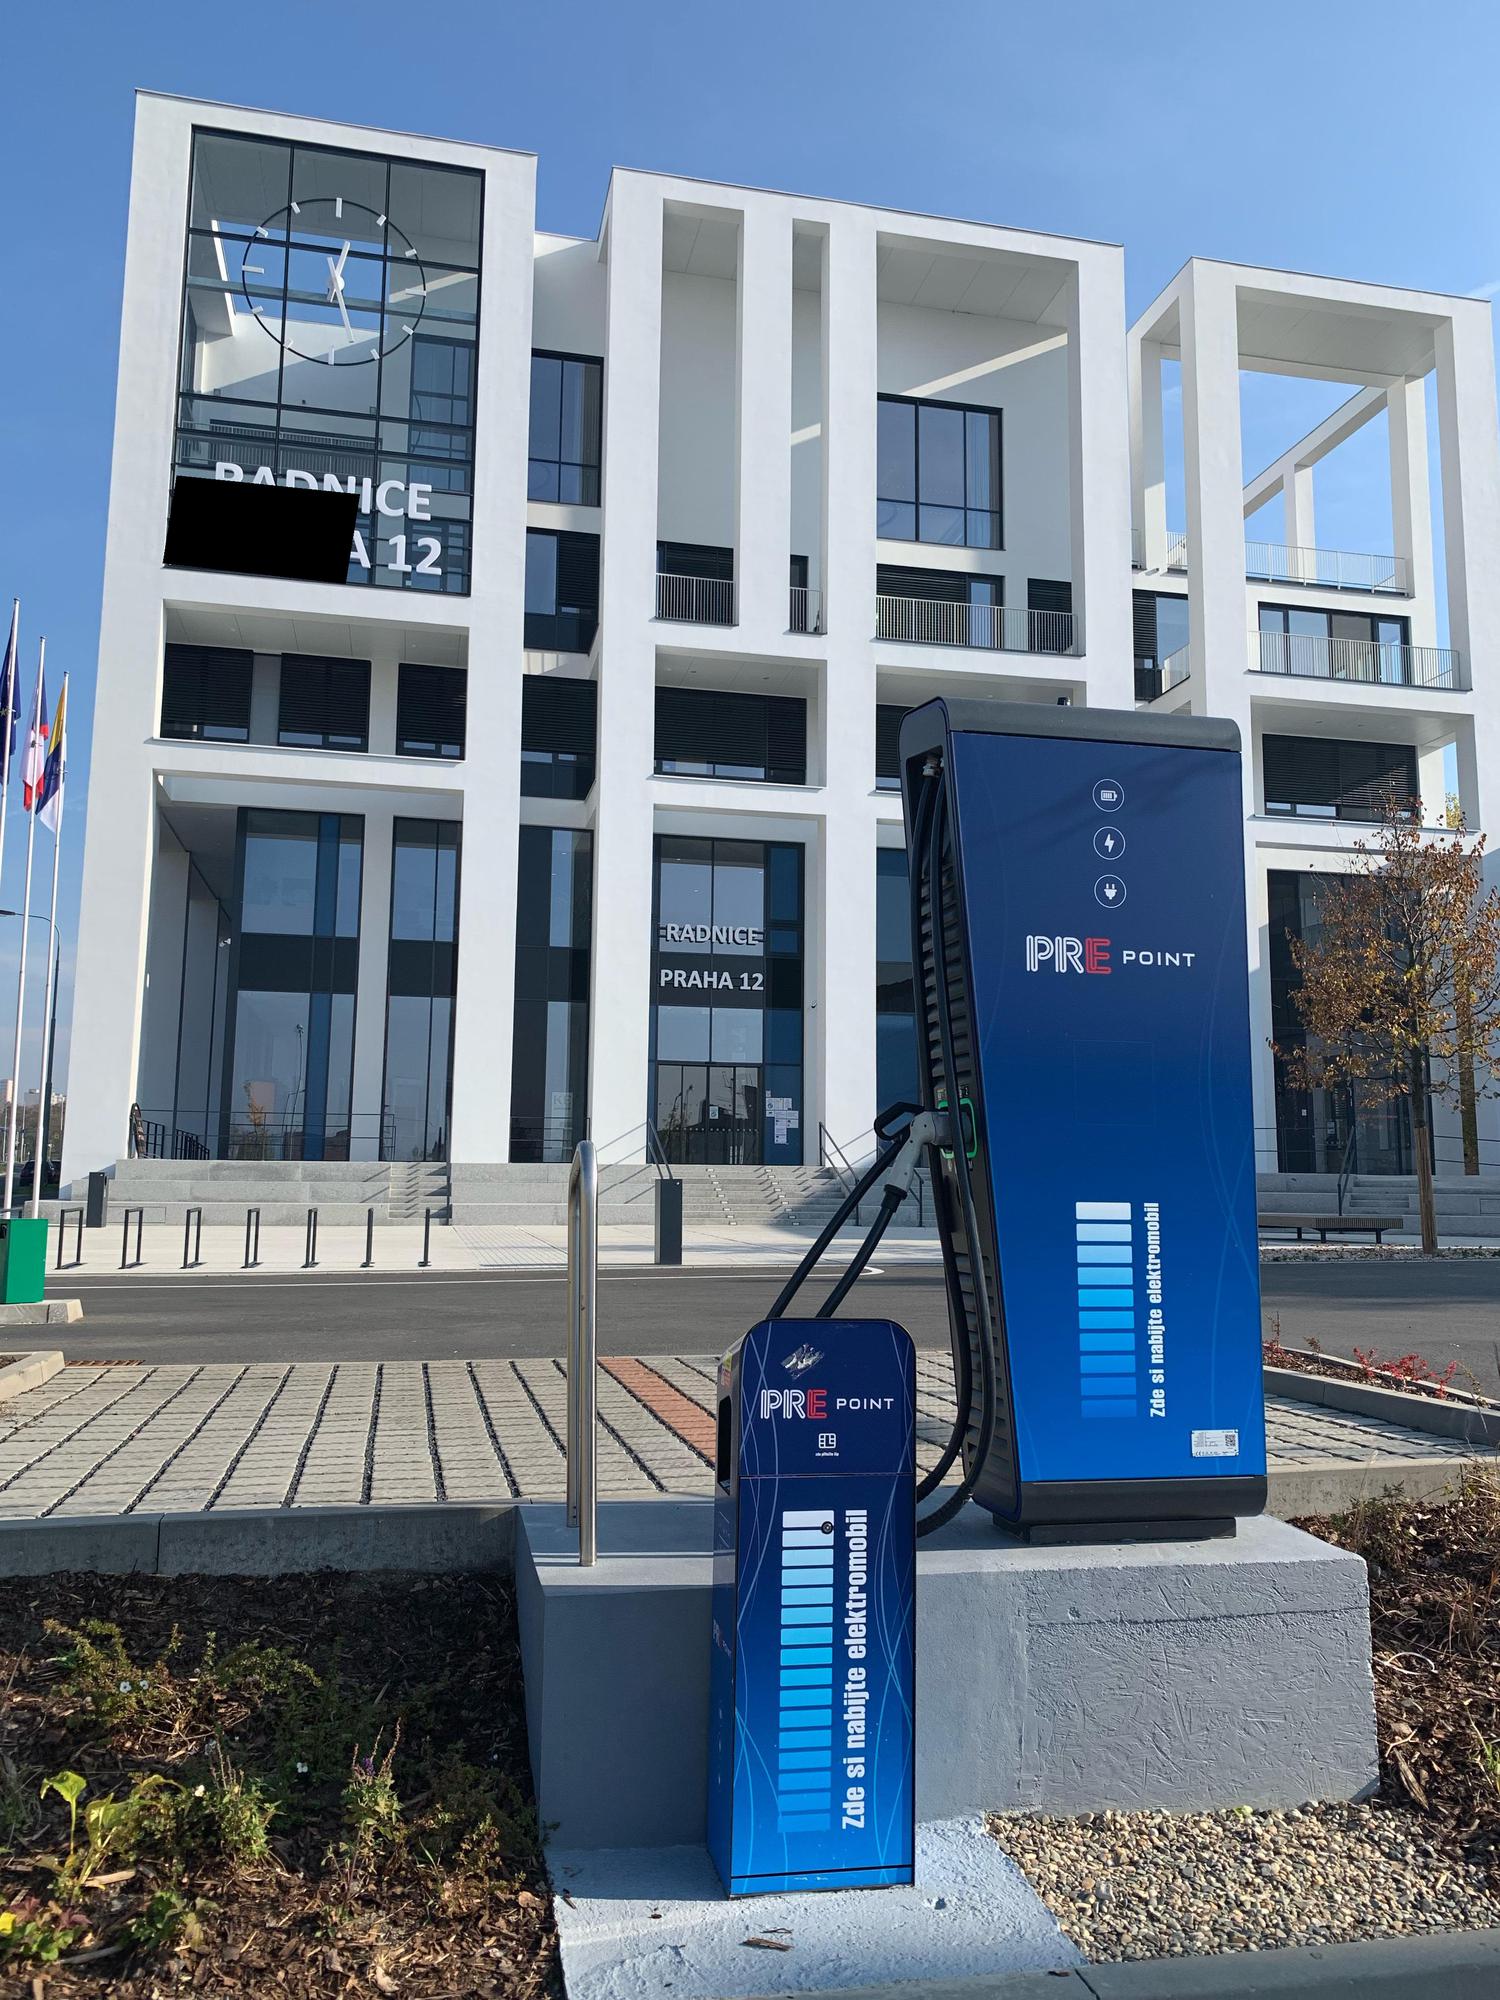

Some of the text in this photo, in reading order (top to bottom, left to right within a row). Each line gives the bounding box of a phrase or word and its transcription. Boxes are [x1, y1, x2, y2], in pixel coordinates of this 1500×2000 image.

[388, 534, 442, 576] 12
[666, 923, 759, 946] RADNICE
[1026, 935, 1196, 975] PRE POINT
[660, 969, 764, 991] PRAHA 12
[1143, 1202, 1166, 1418] Zde si nabijte elektromobil
[760, 1389, 894, 1420] PRE POINT
[842, 1509, 870, 1830] Zde si nabijte elektromobil
